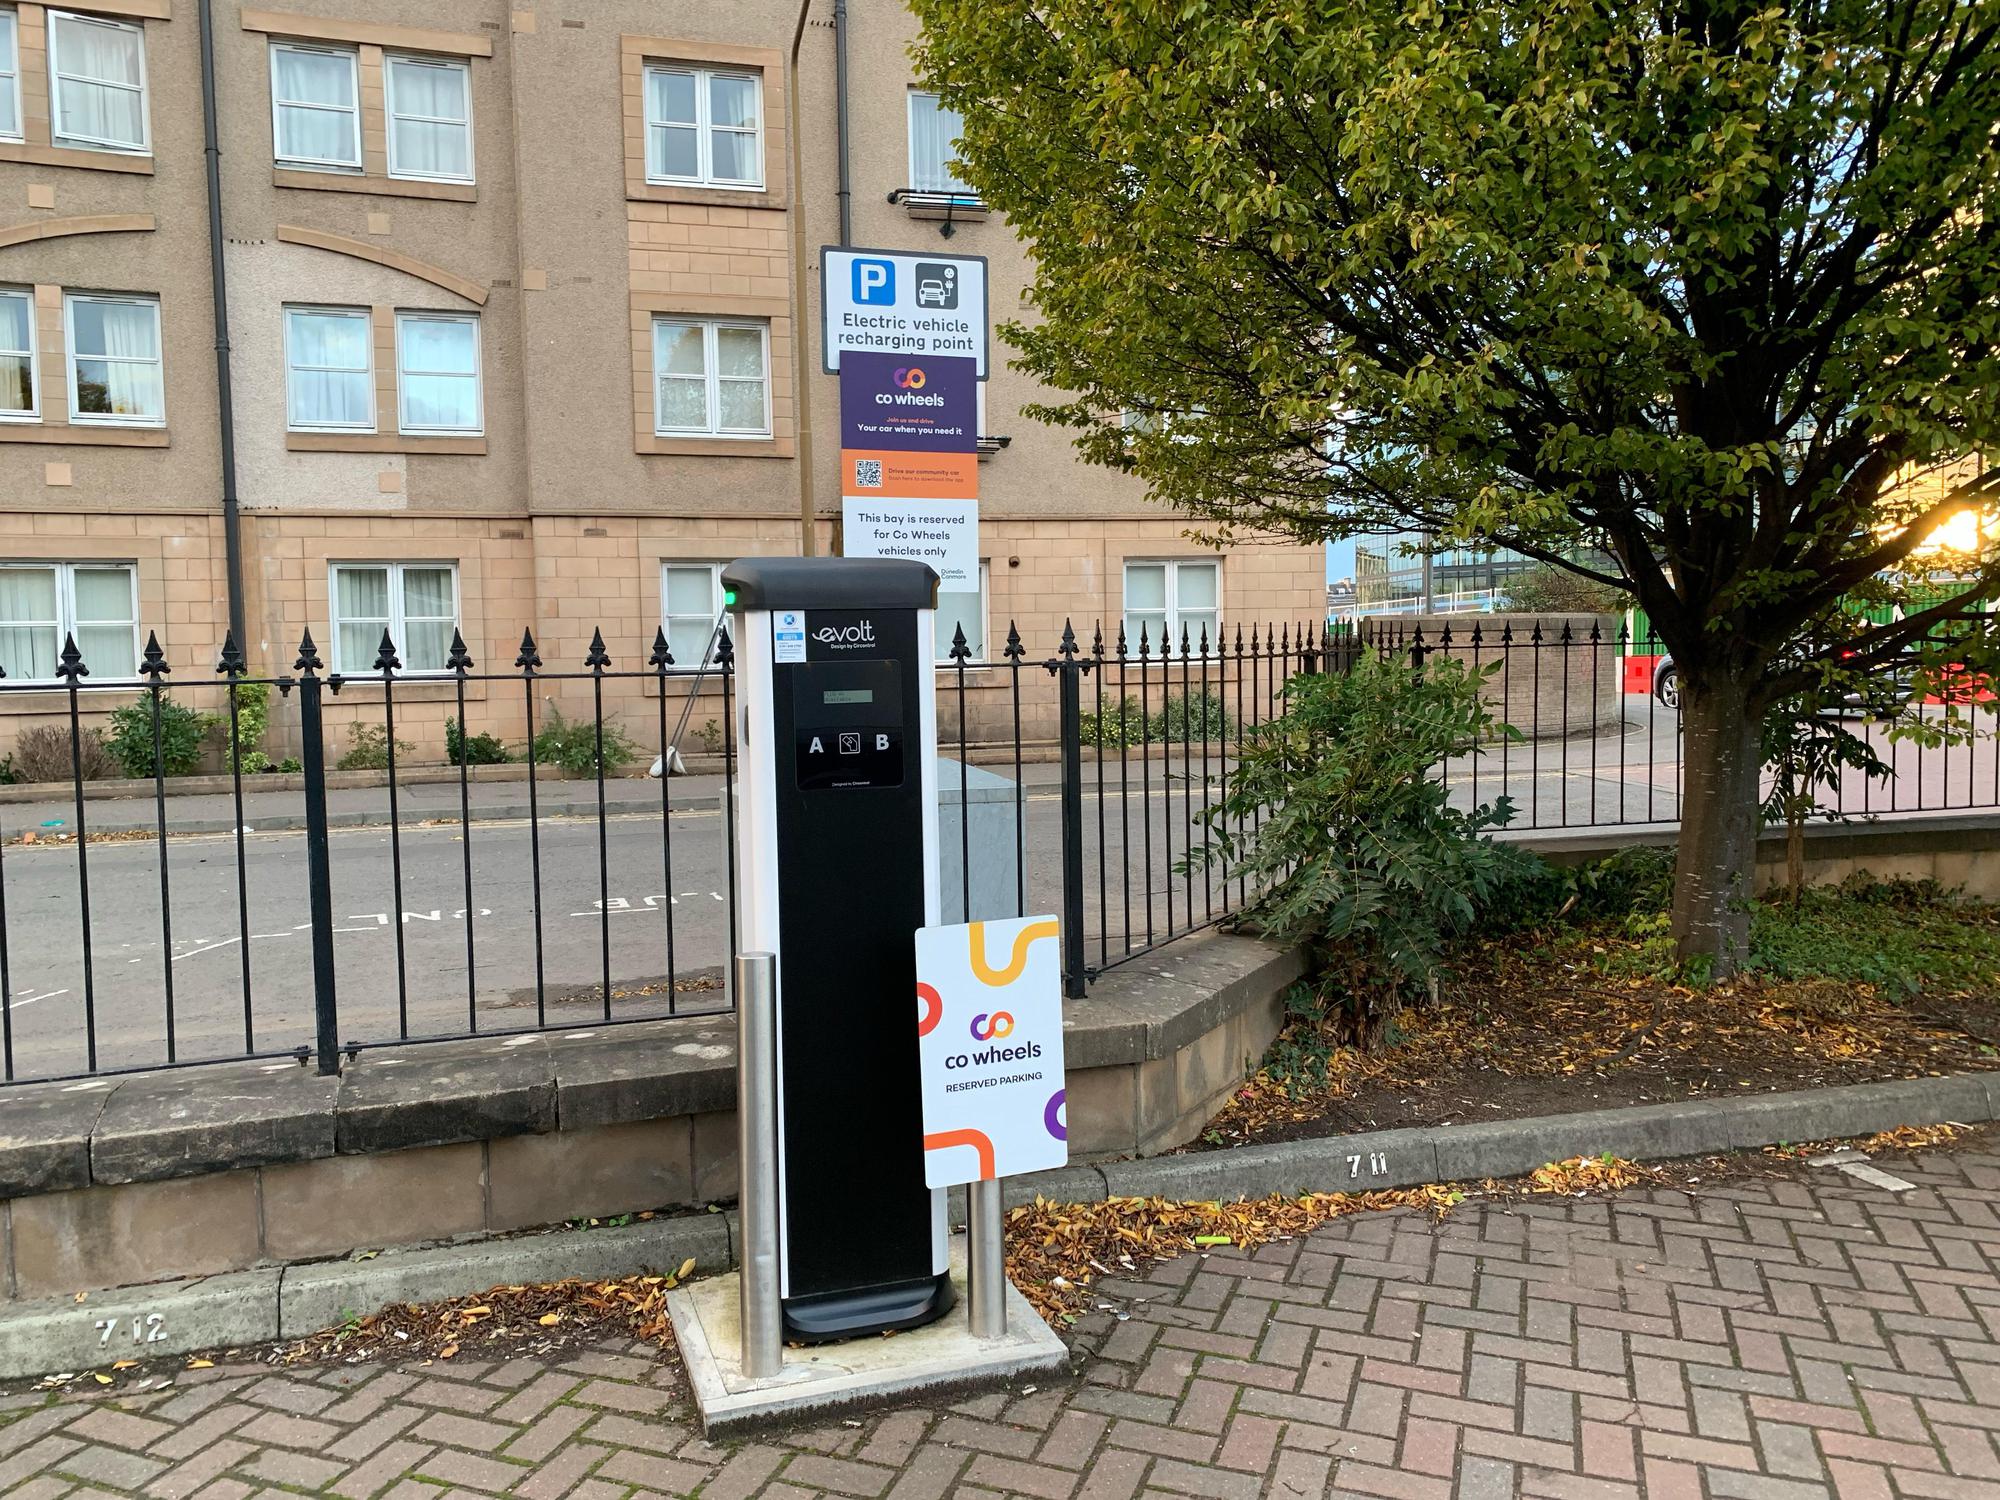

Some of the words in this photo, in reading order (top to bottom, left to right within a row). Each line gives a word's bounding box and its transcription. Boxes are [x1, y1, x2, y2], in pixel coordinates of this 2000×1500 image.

[860, 264, 886, 300] P
[843, 313, 906, 330] Electric
[913, 318, 969, 332] vehicle
[838, 332, 925, 349] recharging
[933, 336, 973, 351] point
[875, 393, 893, 404] co
[895, 391, 944, 407] wheels
[857, 423, 877, 432] Your
[894, 425, 916, 433] when
[918, 427, 933, 435] you
[934, 427, 954, 435] need
[955, 427, 962, 435] it
[858, 513, 881, 523] This
[884, 513, 904, 525] bay
[907, 514, 916, 523] is
[919, 514, 965, 524] reserved
[874, 529, 889, 539] for
[893, 530, 908, 539] Co
[911, 530, 950, 540] Wheels
[878, 546, 921, 556] vehicles
[924, 546, 947, 558] only
[811, 620, 875, 642] evolt
[809, 737, 824, 753] A
[876, 734, 889, 750] B
[945, 1053, 968, 1069] co
[972, 1041, 1041, 1066] wheels
[946, 1078, 997, 1093] RESERVED
[1000, 1071, 1043, 1085] PARKING
